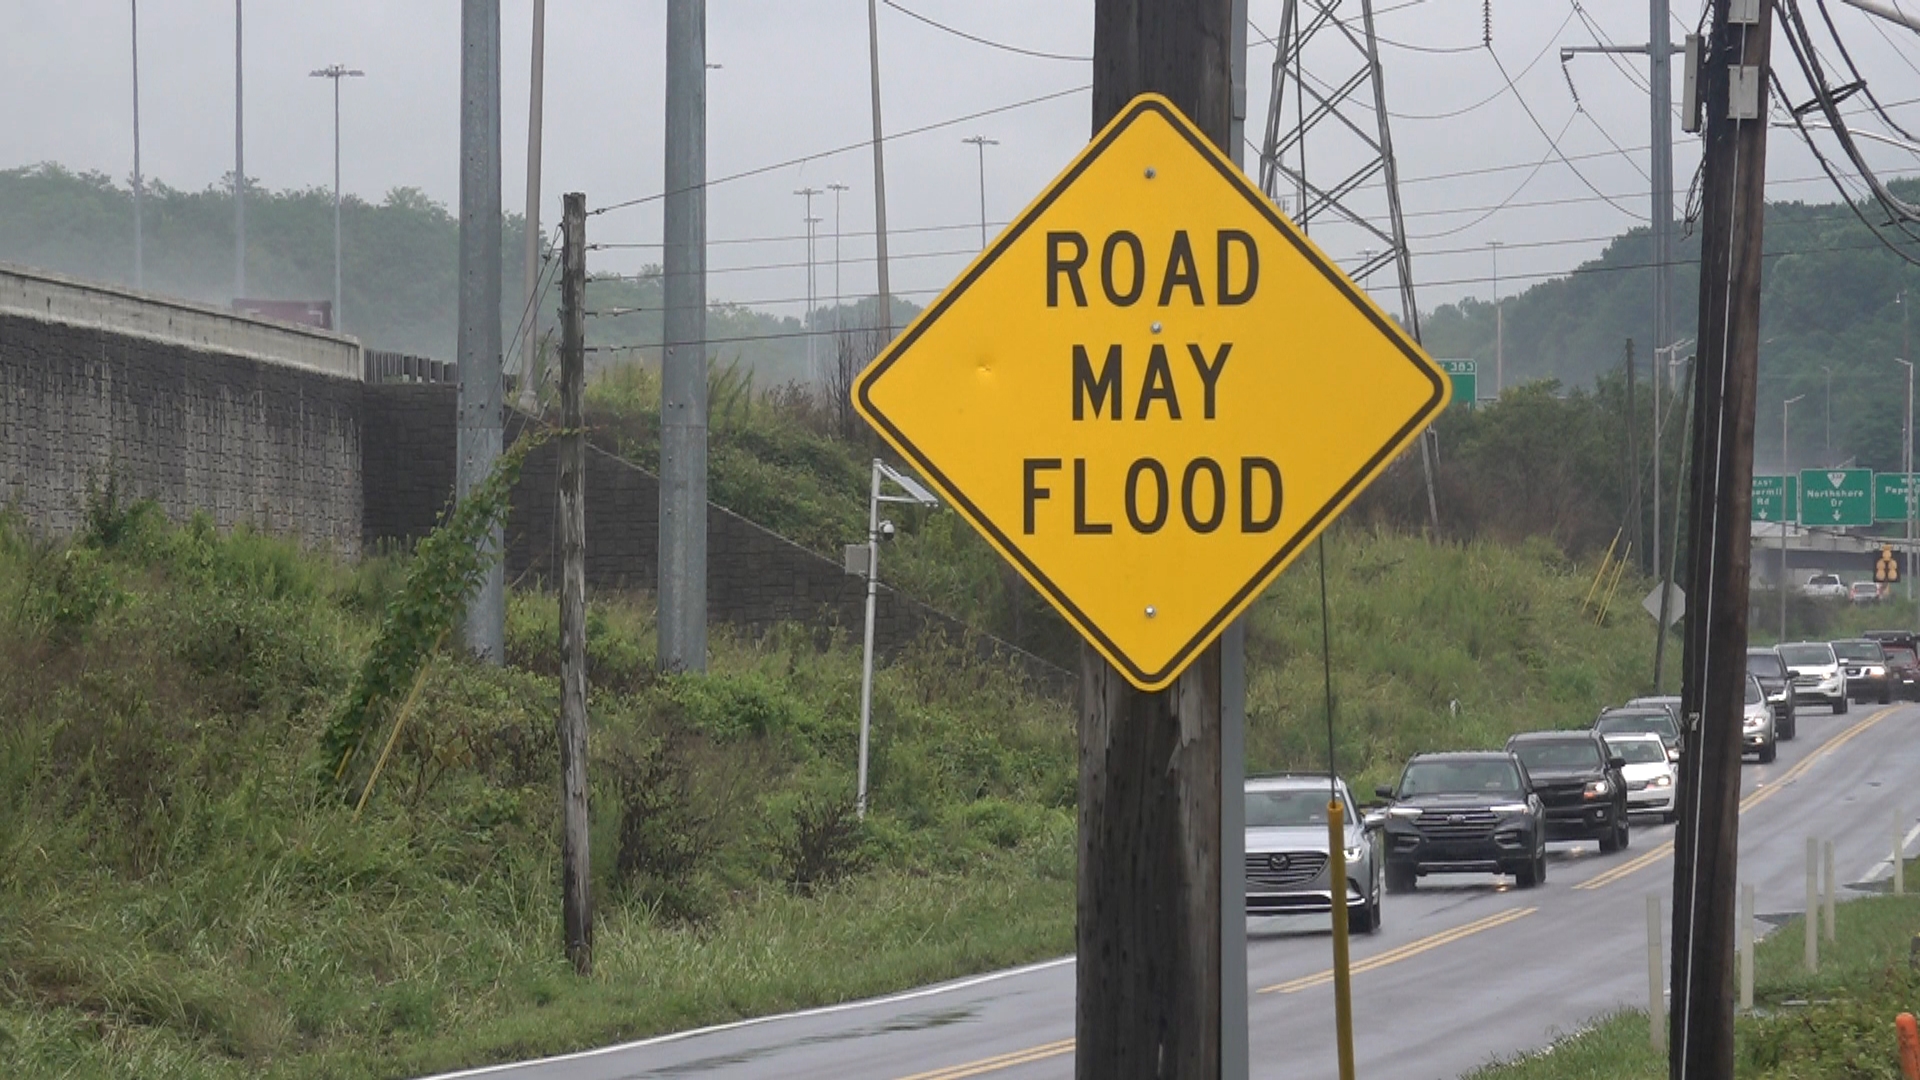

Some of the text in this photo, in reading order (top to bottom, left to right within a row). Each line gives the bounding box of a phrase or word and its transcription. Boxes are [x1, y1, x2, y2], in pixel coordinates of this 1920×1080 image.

[1047, 230, 1259, 307] ROAD
[1073, 344, 1232, 420] MAY
[1024, 457, 1282, 534] FLOOD
[1756, 497, 1770, 505] Rd
[1807, 489, 1864, 498] Northshore
[1830, 498, 1844, 507] Dr
